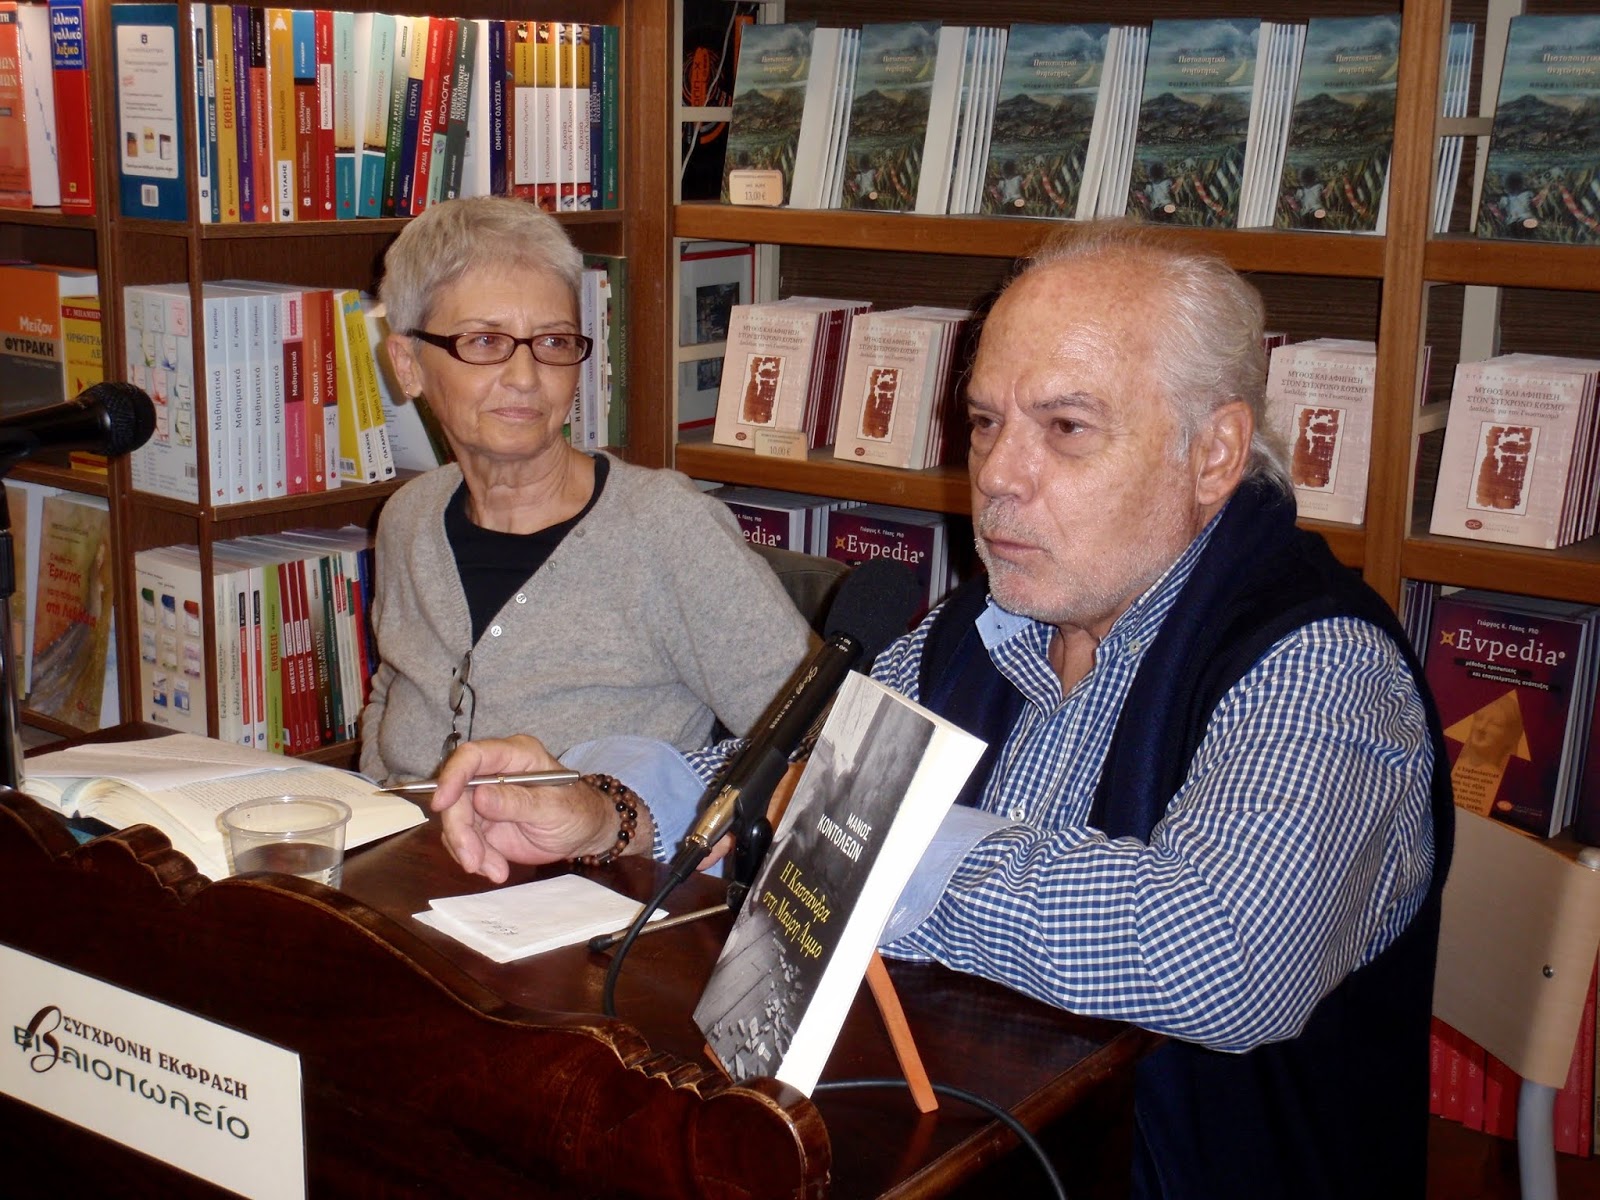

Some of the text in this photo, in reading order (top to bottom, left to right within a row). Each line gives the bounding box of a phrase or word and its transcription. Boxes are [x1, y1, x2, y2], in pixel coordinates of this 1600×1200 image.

[223, 88, 233, 129] ΕΚΘΕΣΕΙΣ
[409, 83, 418, 116] ΙΣΤΟΡΙΑ
[439, 75, 450, 124] ΒΙΟΛΟΓΙΑ
[450, 88, 458, 119] ΚΕΙΜΕΝΑ
[422, 110, 433, 146] ΙΣΤΟΡΙΑ
[5, 337, 54, 357] ΦΥΤΡΑΚΗ
[619, 325, 627, 386] ΜΑΘΗΜΑΤΙΚΑ
[290, 351, 299, 396] Μαθηματικά
[311, 372, 320, 404] Φυσική
[325, 351, 334, 396] ΧΗΜΕΙΑ
[1281, 379, 1367, 393] ΣΤΟΝ ΣΥΓΧΡΟΝΟ ΚΟΣΜΟ
[1288, 371, 1313, 379] ΜΥΘΟΣ
[1329, 375, 1363, 384] ΑΦΗΓΗΣΗ
[214, 370, 223, 431] Μαθηματικά
[234, 368, 244, 428] Μαθηματικά
[254, 367, 263, 426] Μαθηματικά
[272, 365, 282, 424] Μαθηματικά
[1467, 395, 1564, 411] ΣΤΟΝ ΣΥΓΧΡΟΝΟ ΚΟΣΜΟ
[1475, 386, 1503, 395] ΜΥΘΟΣ
[1520, 391, 1560, 400] ΑΦΗΓΗΣΗ
[364, 433, 373, 463] ΠΑΤΑΚΗΣ
[379, 428, 389, 458] ΠΑΤΑΚΗΣ
[743, 526, 777, 547] edia
[1477, 619, 1500, 630] Γιώργος
[1508, 625, 1525, 633] Γάκης
[1528, 627, 1539, 635] PhD
[270, 633, 278, 672] ΕΚΘΕΣΕΙΣ
[288, 660, 296, 694] ΕΚΘΕΣΕΙΣ
[298, 658, 306, 692] ΕΚΘΕΣΕΙΣ
[307, 657, 315, 689] ΕΚΘΕΣΕΙΣ
[817, 814, 863, 862] ΚΟΝΤΟΛΕΩΝ
[846, 813, 872, 841] ΜΑΝΟΣ
[779, 861, 831, 922] Η Κασσάνδρα
[763, 891, 823, 958] στη Μαύρη Άμμο
[63, 1015, 248, 1100] ΣΥΓΧΡΟΝΗ ΕΚΦΡΑΣΗ
